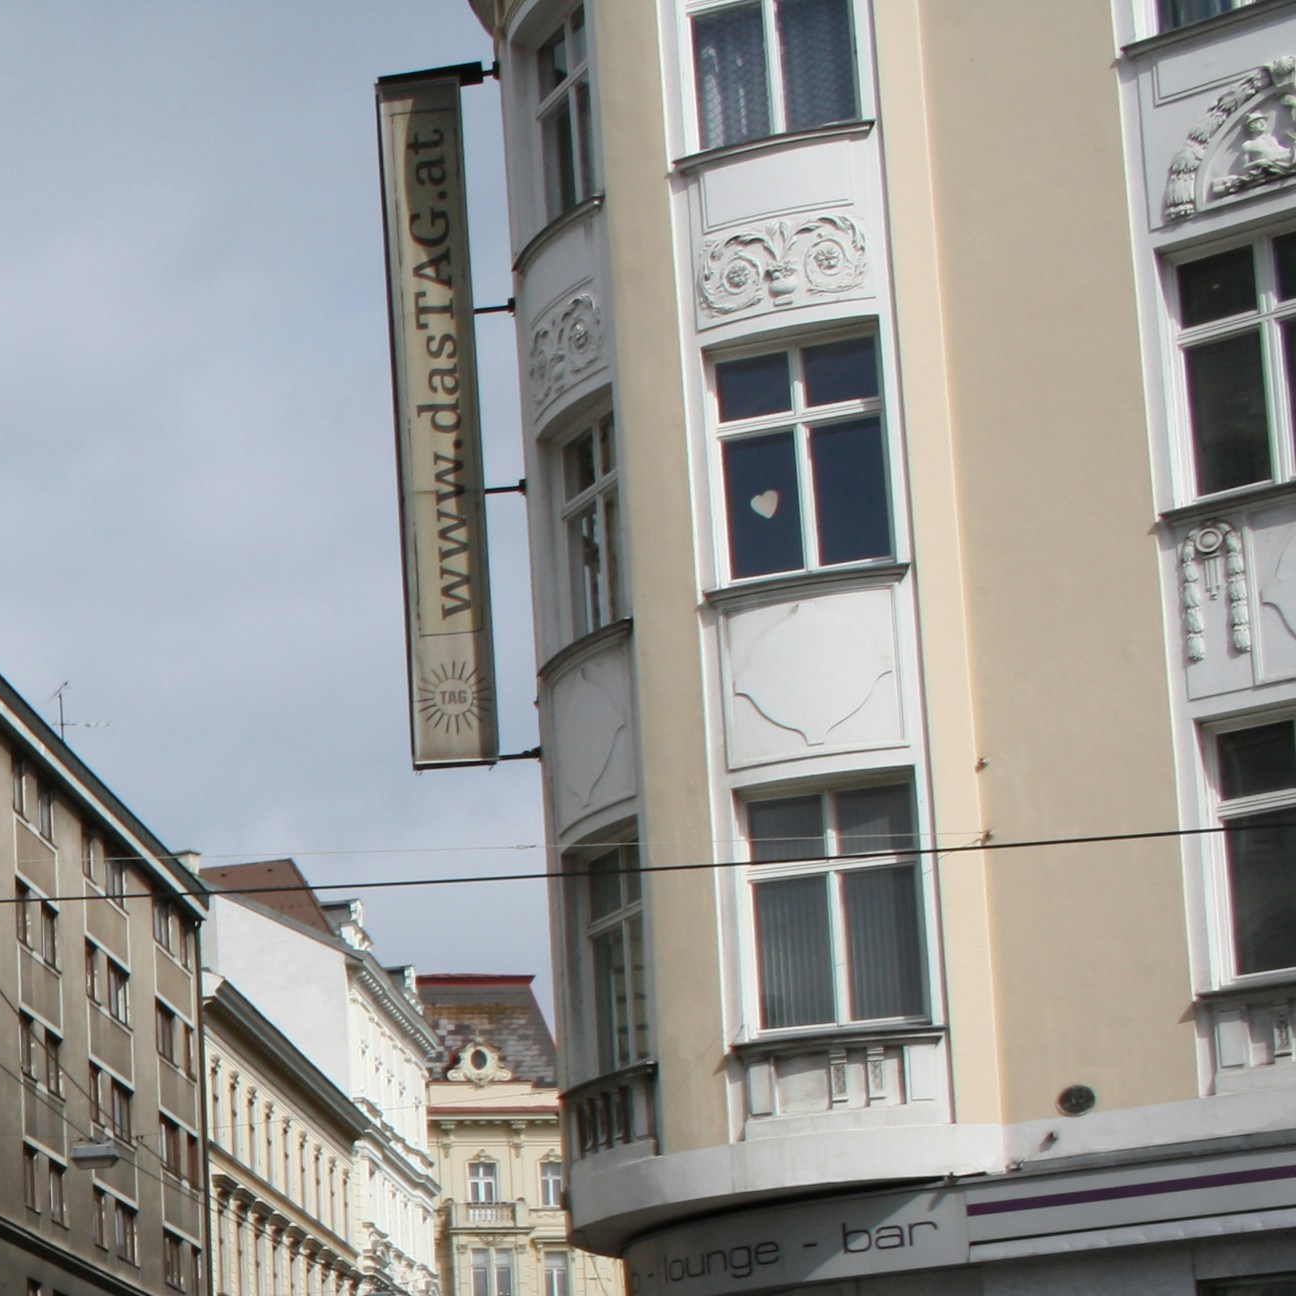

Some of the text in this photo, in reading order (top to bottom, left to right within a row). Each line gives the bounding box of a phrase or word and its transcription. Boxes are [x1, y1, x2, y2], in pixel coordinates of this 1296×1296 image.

[404, 125, 470, 621] www.dasTAG.at
[439, 690, 468, 705] TAG
[664, 1240, 780, 1284] lounge
[842, 1218, 938, 1254] bar
